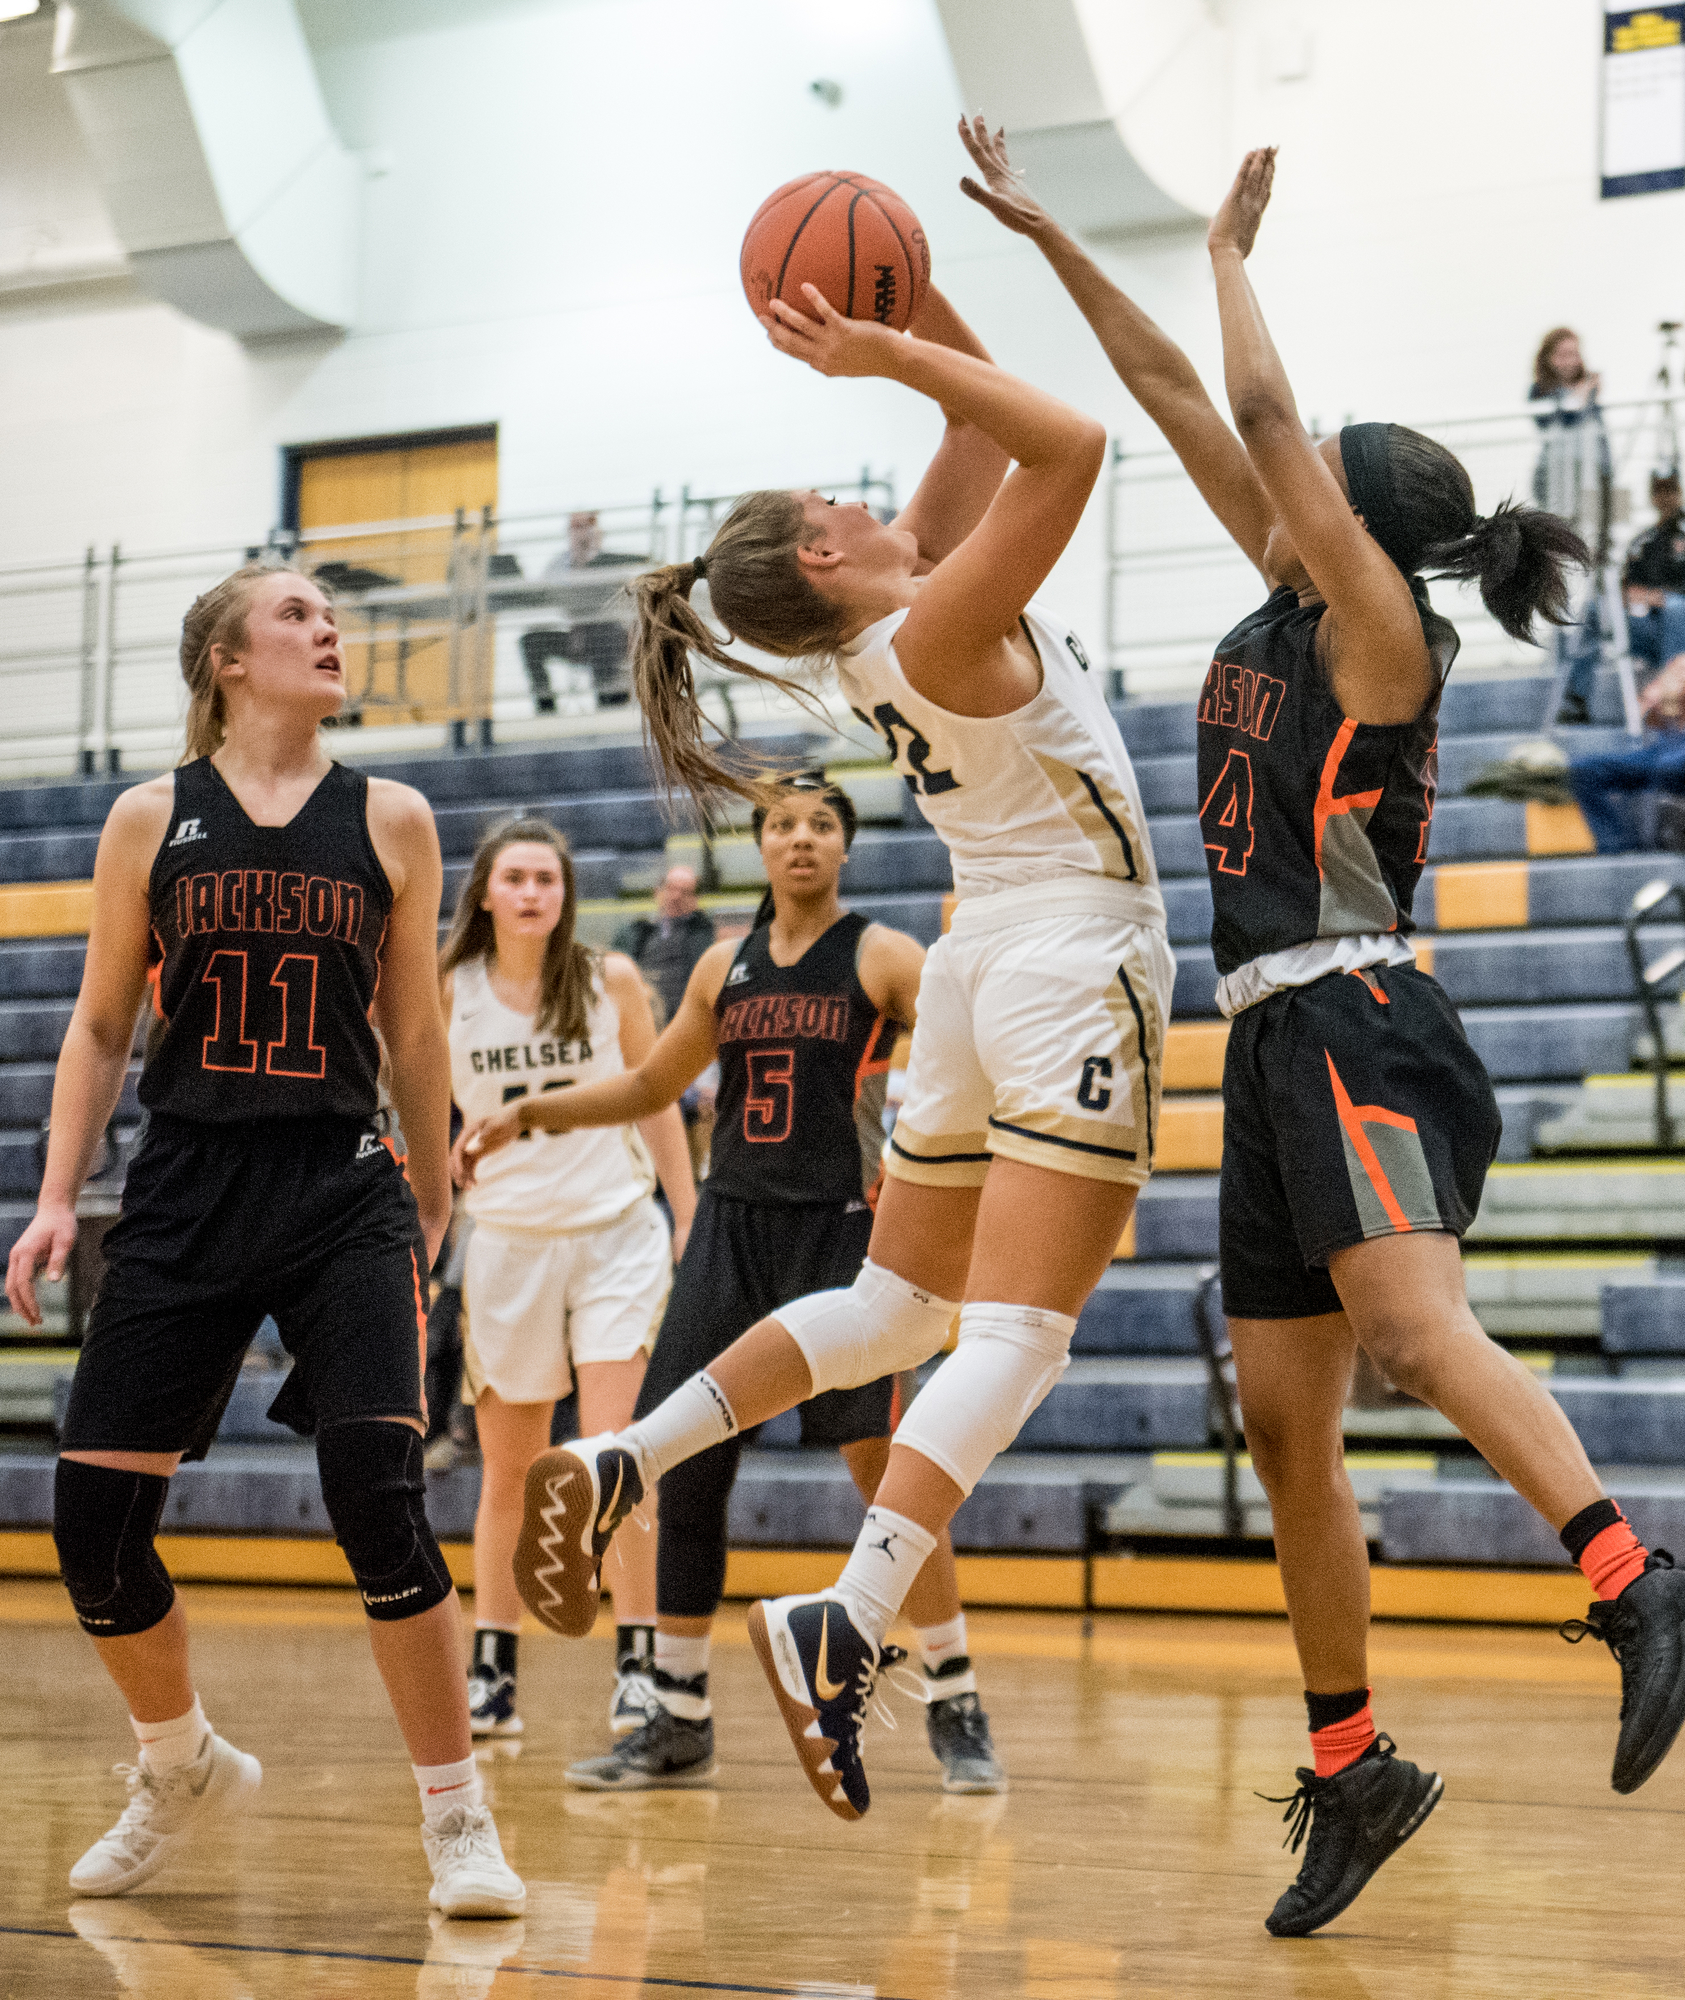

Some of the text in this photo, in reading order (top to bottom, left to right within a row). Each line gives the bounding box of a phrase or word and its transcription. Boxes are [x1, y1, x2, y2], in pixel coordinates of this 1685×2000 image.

[1199, 748, 1254, 877] 4
[176, 869, 364, 945] JACKSON
[202, 949, 326, 1079] 11
[470, 1035, 593, 1073] CHELSEA
[743, 1049, 795, 1142] 5
[1077, 1056, 1112, 1111] C
